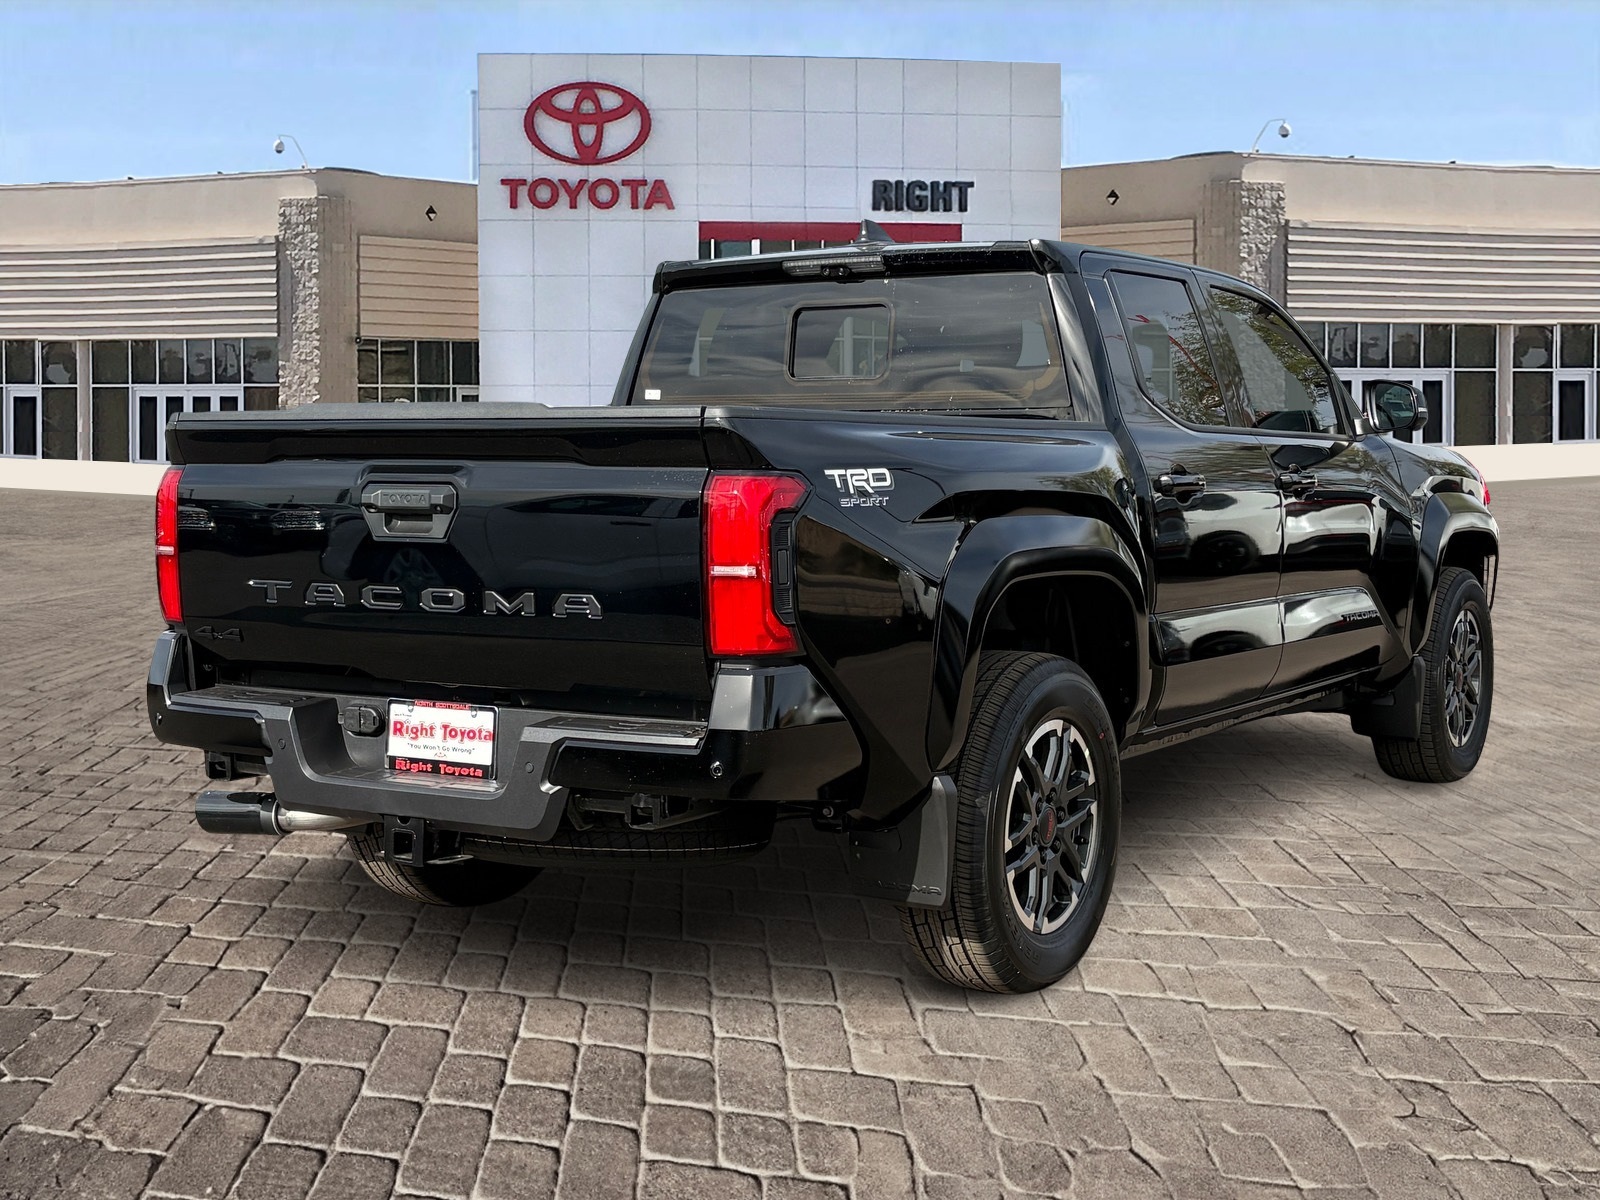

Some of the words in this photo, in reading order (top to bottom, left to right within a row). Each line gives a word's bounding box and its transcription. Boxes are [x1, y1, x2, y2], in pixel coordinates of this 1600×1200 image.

[500, 178, 676, 210] TOYOTA
[872, 179, 975, 212] RIGHT
[823, 467, 895, 495] TRD
[382, 493, 426, 505] TOYOTA
[840, 497, 890, 507] SPORT
[247, 579, 604, 619] TACOMA
[1344, 610, 1380, 621] TACOMA
[415, 700, 434, 708] NORTH
[393, 721, 436, 741] Right
[441, 724, 493, 742] Toyota
[395, 759, 432, 772] Right
[439, 763, 483, 777] Toyota
